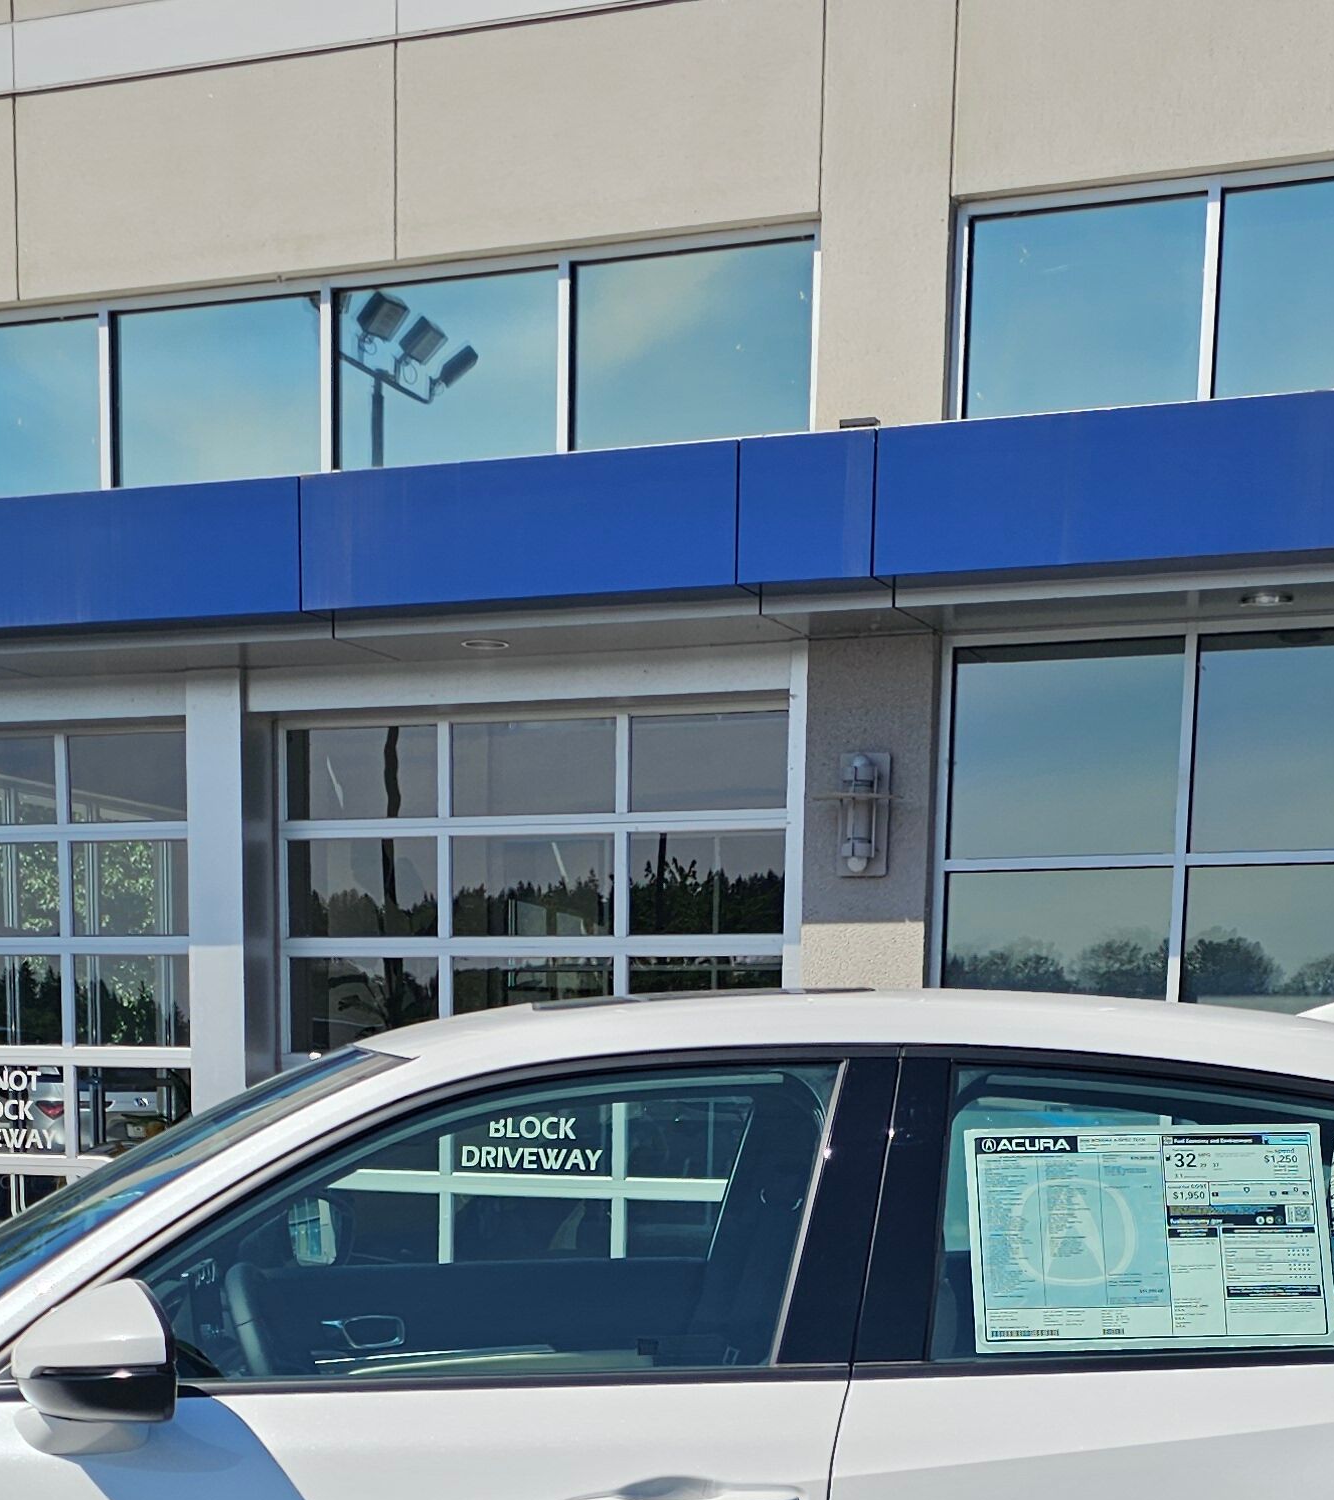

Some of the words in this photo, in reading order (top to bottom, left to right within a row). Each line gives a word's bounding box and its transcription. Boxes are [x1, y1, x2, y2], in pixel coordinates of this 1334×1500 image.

[489, 1116, 577, 1140] BLOCK
[997, 1138, 1071, 1151] ACURA
[461, 1145, 603, 1171] DRIVEWAY
[1174, 1153, 1197, 1168] 32
[1264, 1155, 1298, 1164] $1,250
[1172, 1191, 1205, 1200] $1,950
